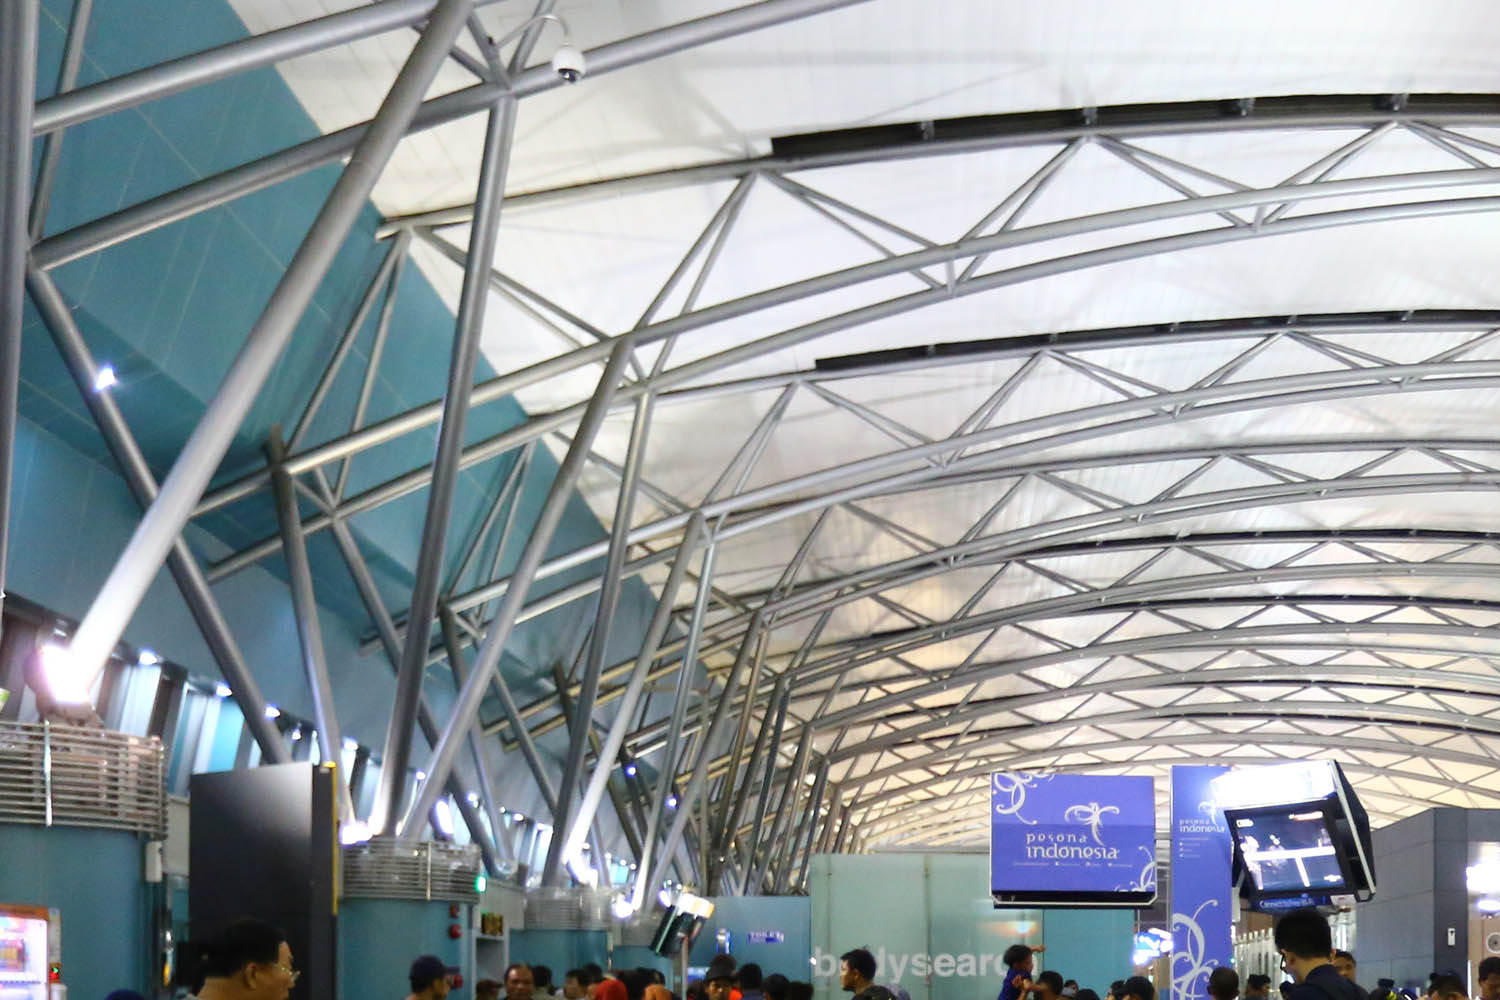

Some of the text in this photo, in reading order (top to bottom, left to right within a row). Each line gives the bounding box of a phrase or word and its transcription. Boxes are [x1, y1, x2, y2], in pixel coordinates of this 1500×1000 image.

[1025, 832, 1088, 845] pesona
[1025, 843, 1120, 859] indonesia
[814, 945, 1038, 983] bdysearc
